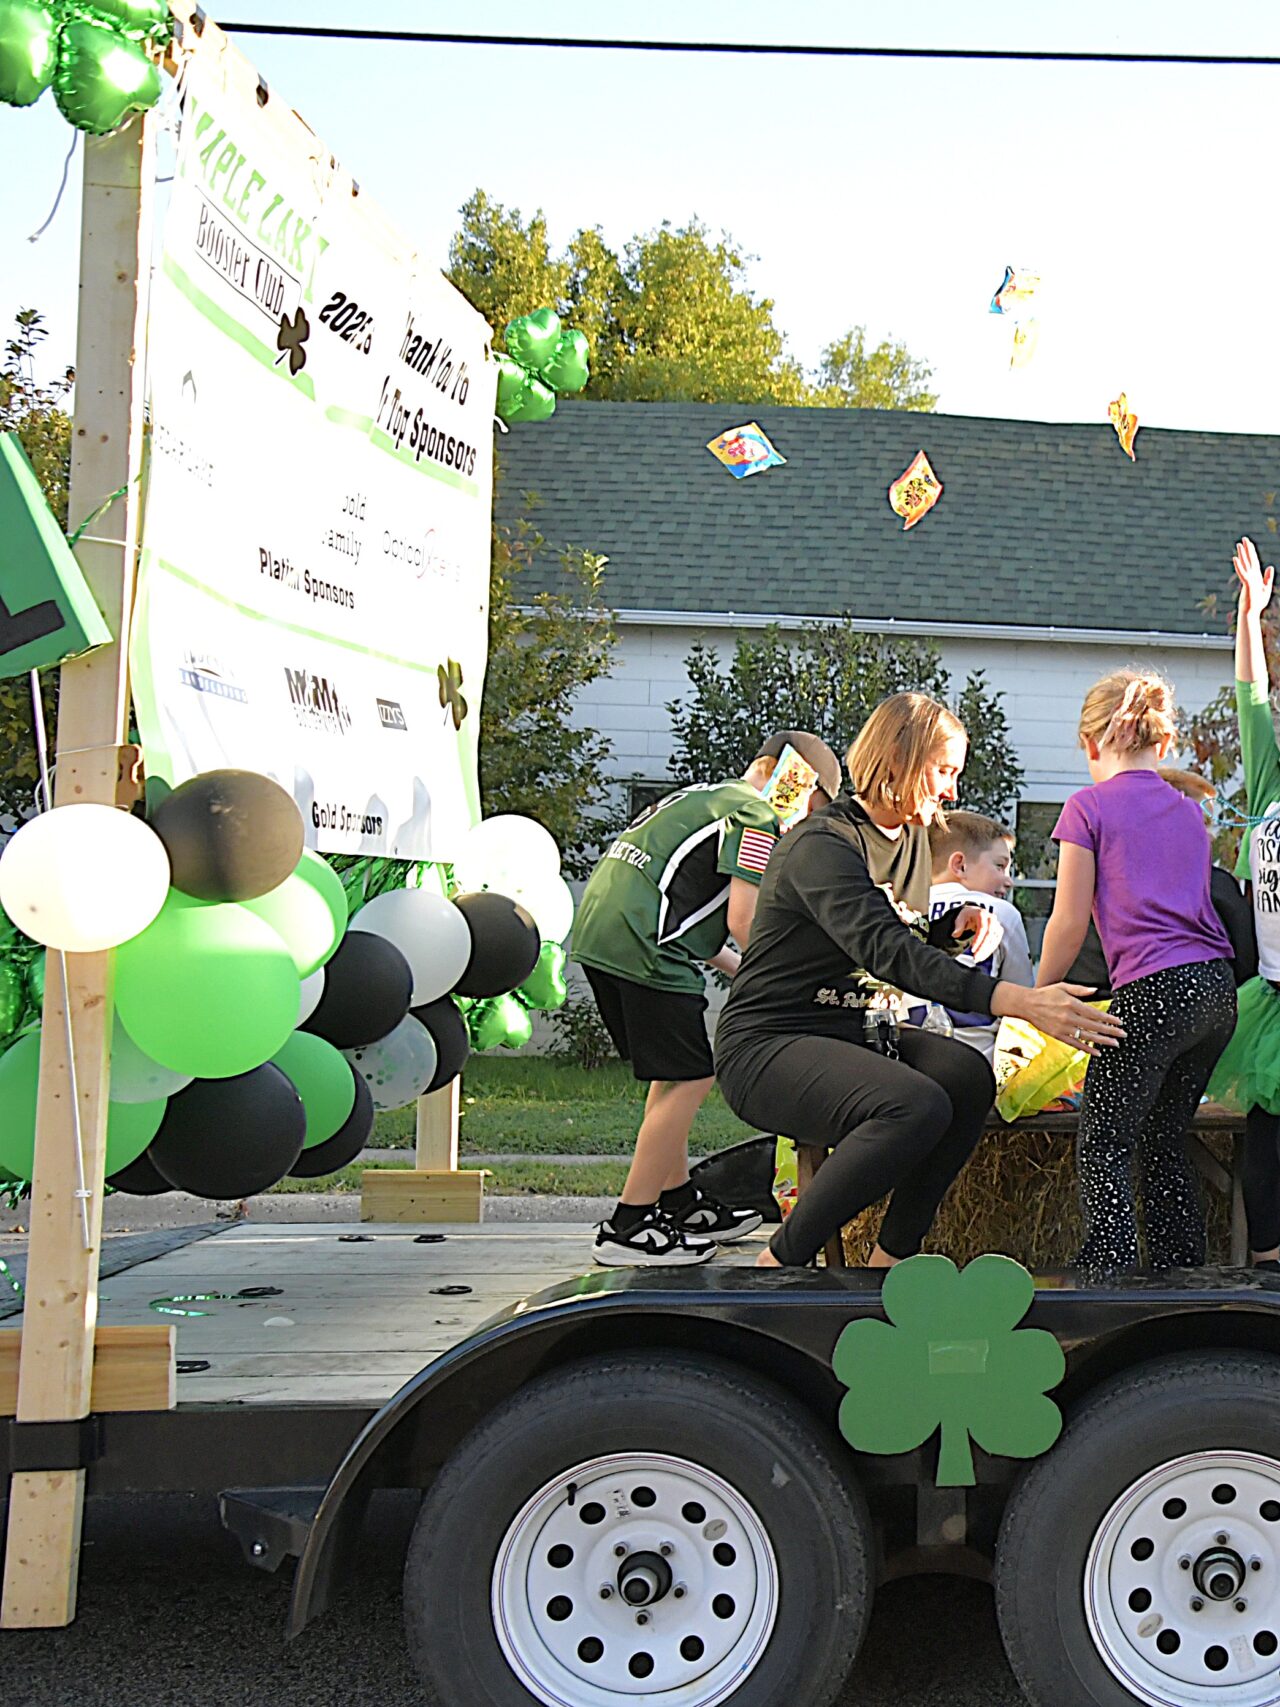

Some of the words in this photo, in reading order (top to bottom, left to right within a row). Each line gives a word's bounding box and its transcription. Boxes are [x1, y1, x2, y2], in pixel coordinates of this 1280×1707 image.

[254, 257, 285, 316] Club
[398, 310, 443, 379] hank
[409, 407, 477, 477] Sponsors
[304, 568, 355, 610] Sponsors
[311, 800, 338, 829] Gold
